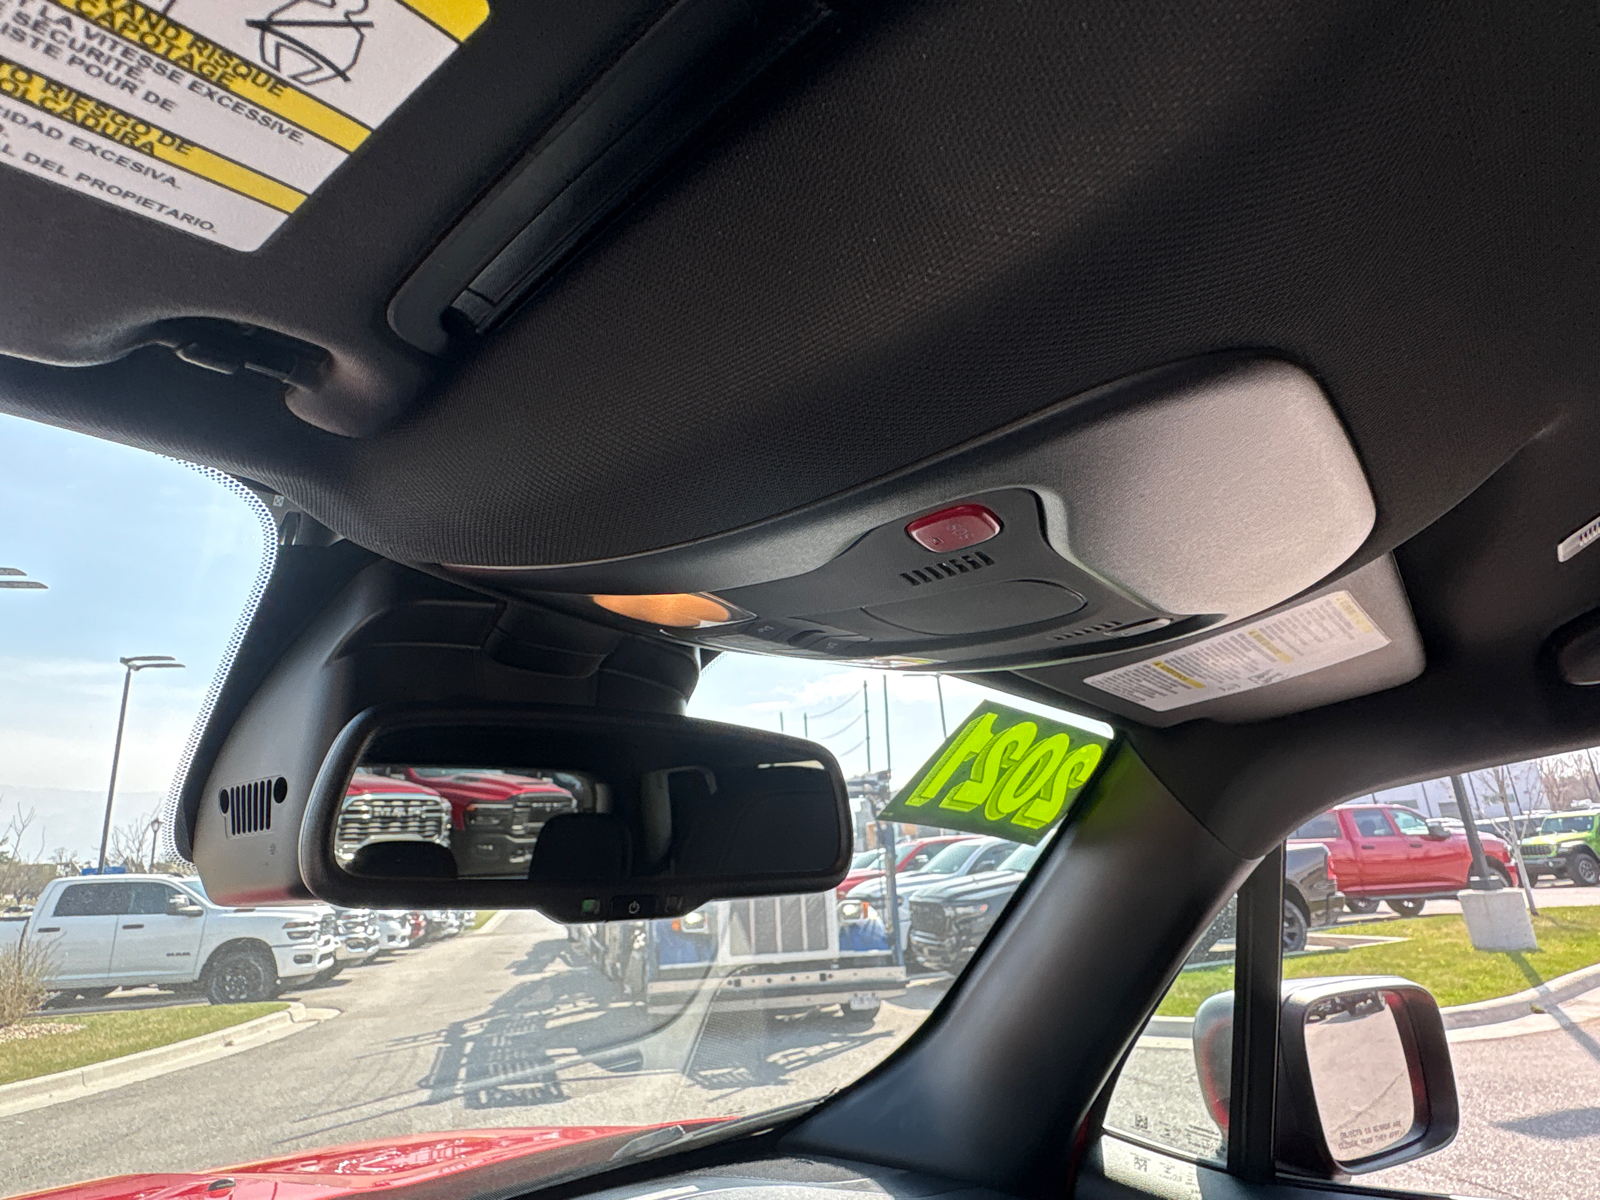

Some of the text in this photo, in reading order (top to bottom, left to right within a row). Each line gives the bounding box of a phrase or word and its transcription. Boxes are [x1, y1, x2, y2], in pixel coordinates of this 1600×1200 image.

[39, 4, 304, 145] LA VITESSE EXCESSIVE.
[67, 54, 138, 95] POUR
[142, 90, 176, 113] DE
[187, 39, 285, 98] RISQUE
[0, 105, 181, 190] IDAD EXCESIVA.
[41, 82, 151, 136] RIESGO
[157, 132, 192, 156] DE
[22, 151, 69, 177] DEL
[75, 172, 217, 234] PROPIETARIO.
